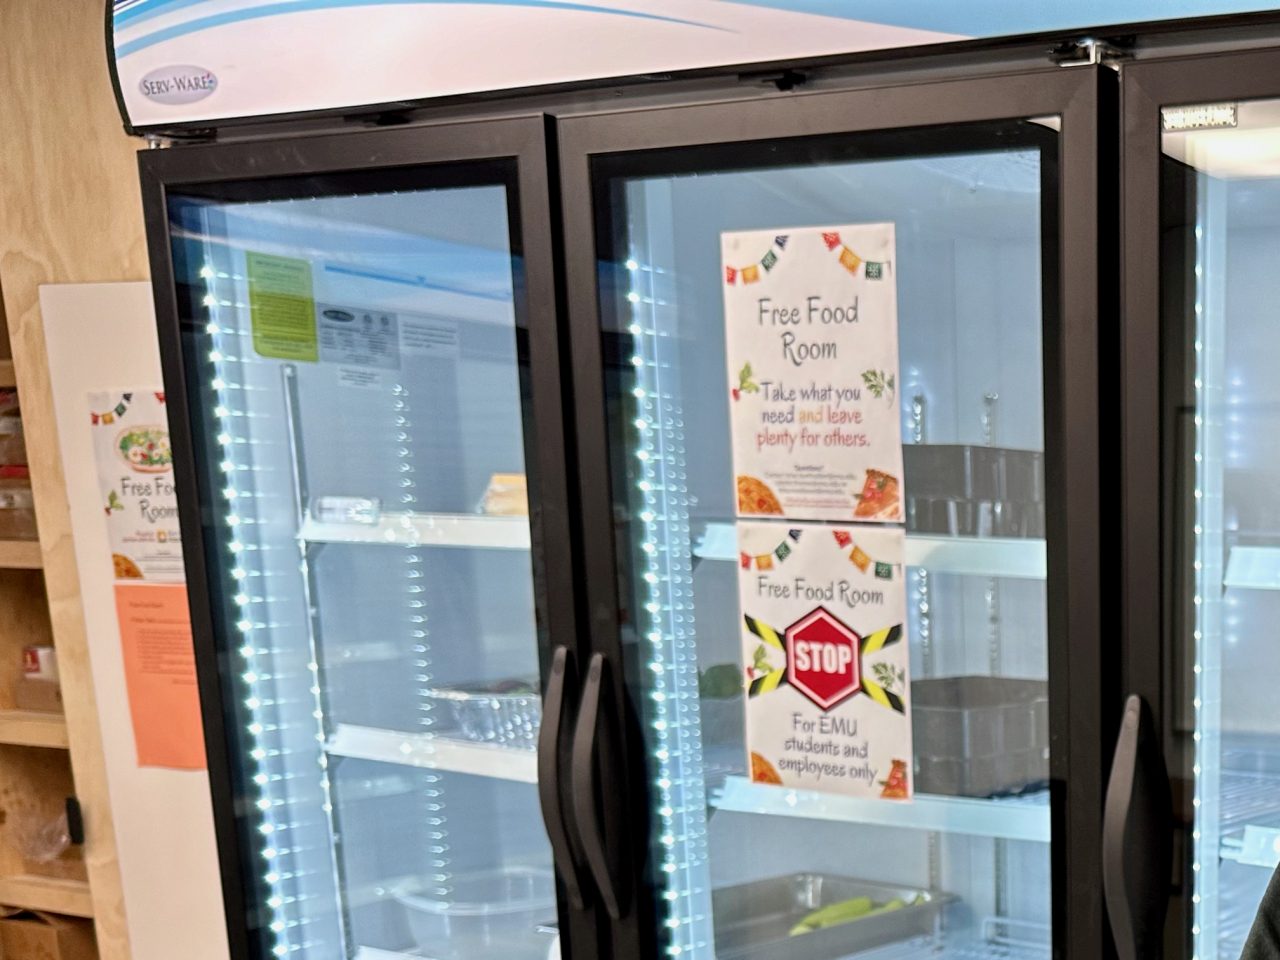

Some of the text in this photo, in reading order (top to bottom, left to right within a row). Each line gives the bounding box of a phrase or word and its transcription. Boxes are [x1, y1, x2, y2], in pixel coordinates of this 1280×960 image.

[758, 296, 859, 326] Free Food
[781, 331, 837, 366] Room
[761, 382, 861, 408] Take what you
[762, 406, 862, 424] need and leave
[757, 427, 871, 452] plenty for others.
[121, 476, 152, 496] Free
[757, 576, 884, 608] Free Food Room
[794, 640, 852, 675] STOP
[792, 712, 858, 737] For EMU
[784, 736, 868, 760] students and
[778, 758, 878, 787] employees only
